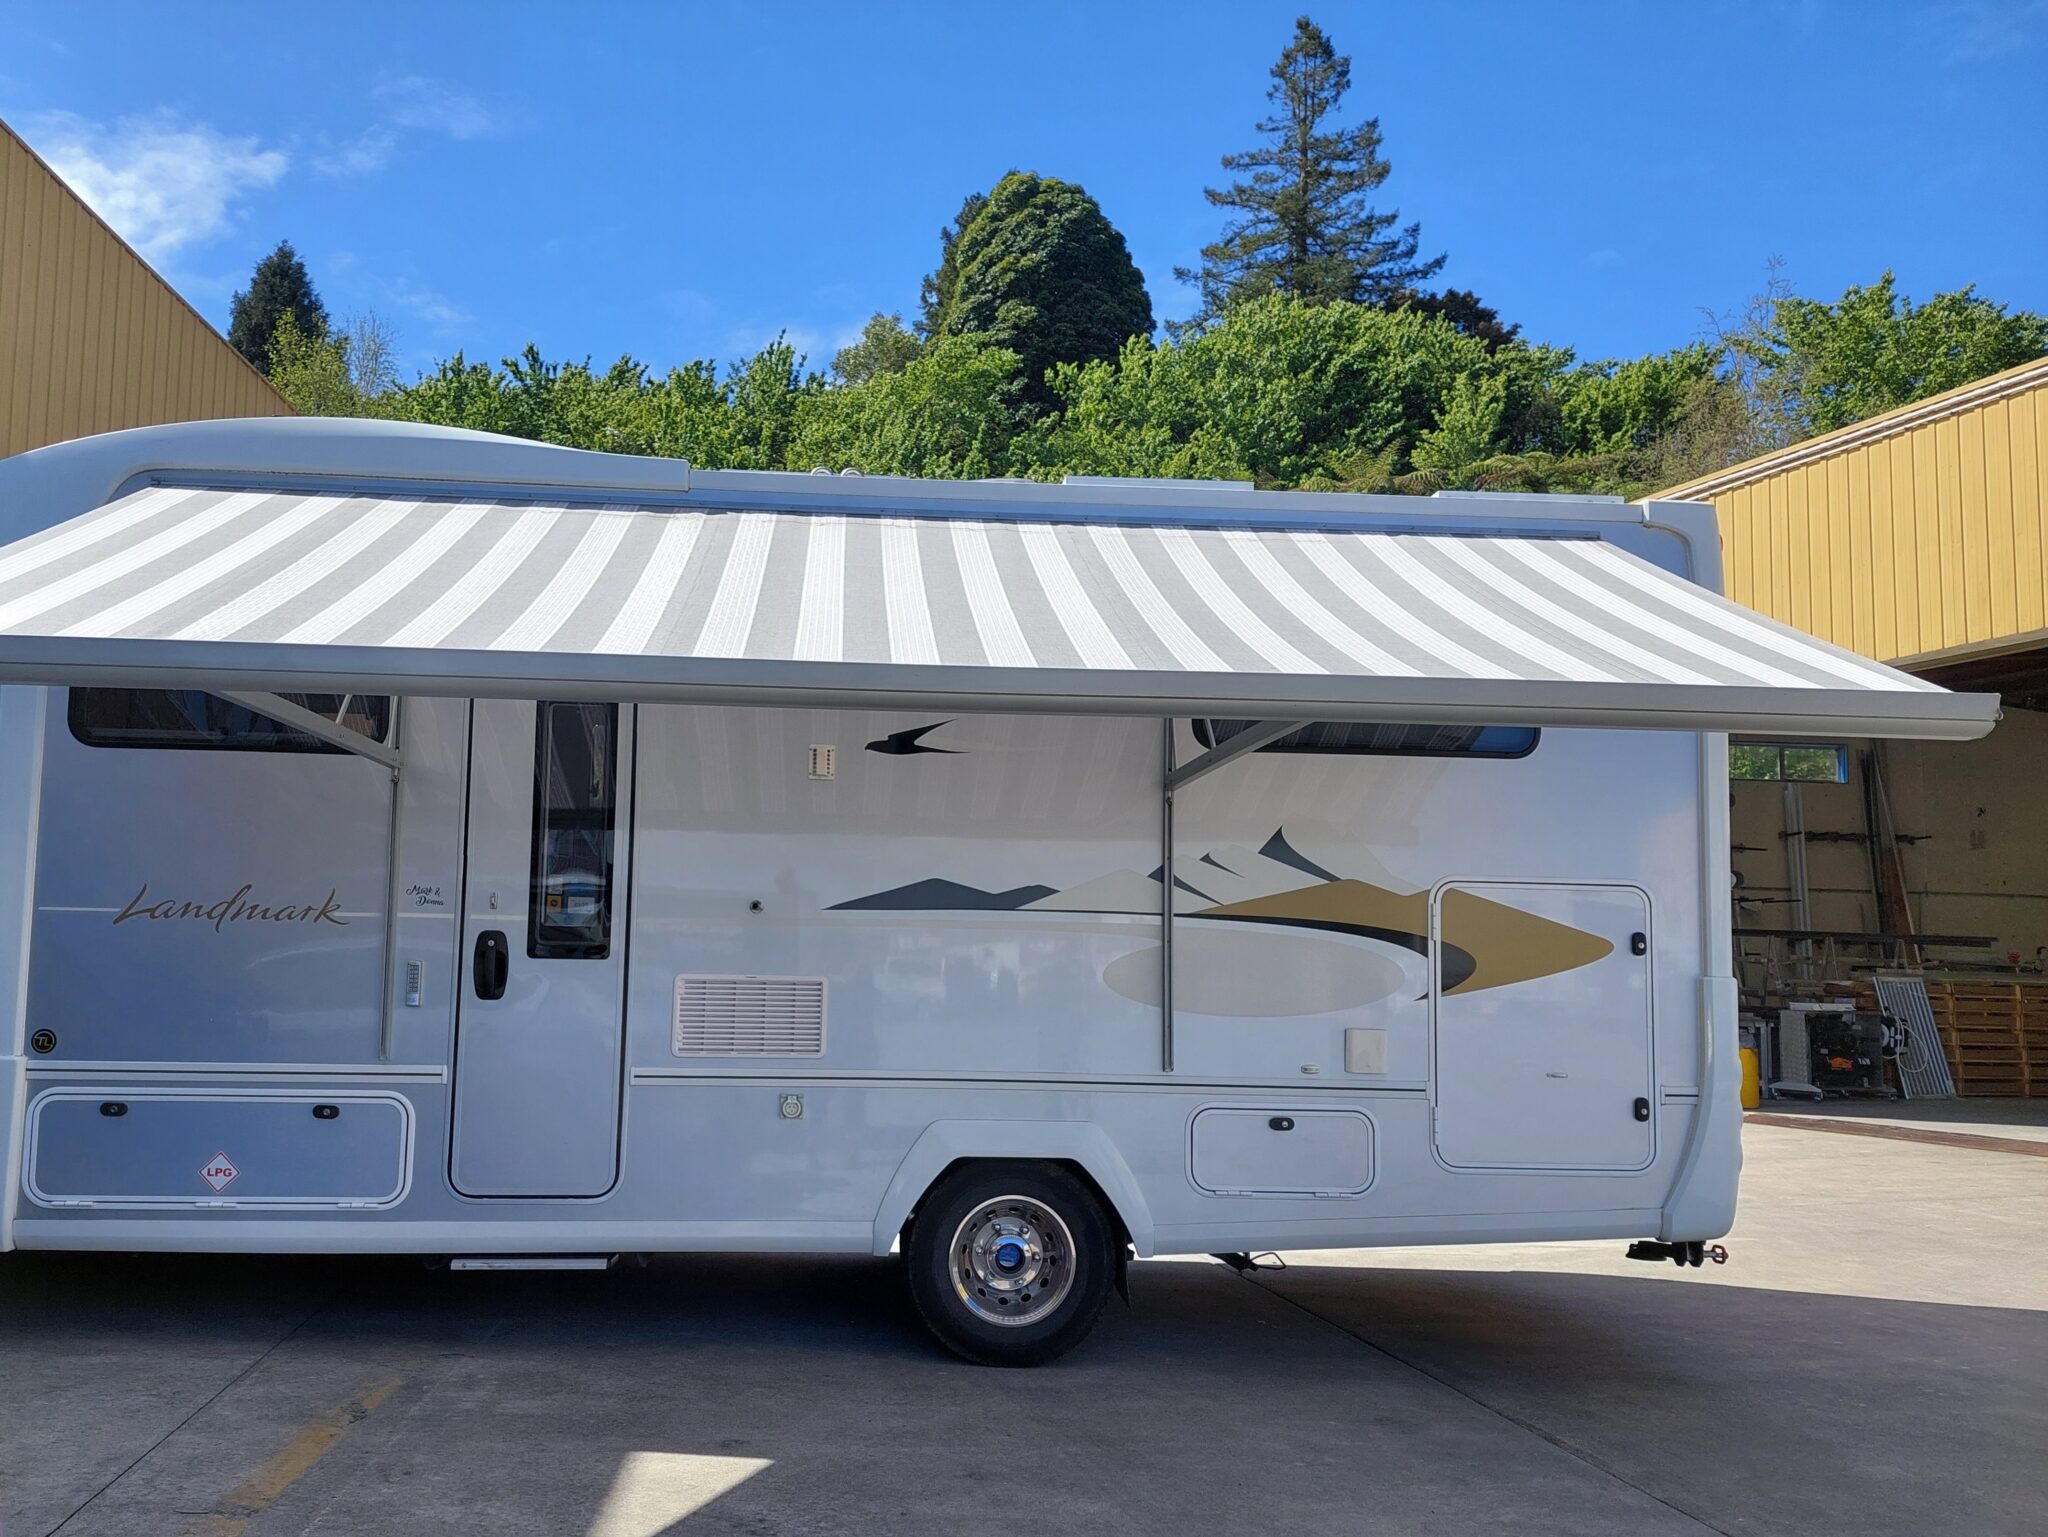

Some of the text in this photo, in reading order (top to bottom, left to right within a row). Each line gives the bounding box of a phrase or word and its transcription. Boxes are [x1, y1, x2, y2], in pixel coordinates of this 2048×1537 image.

[406, 884, 441, 897] Mark &
[112, 883, 350, 934] Landmark
[207, 1167, 233, 1178] LPG
